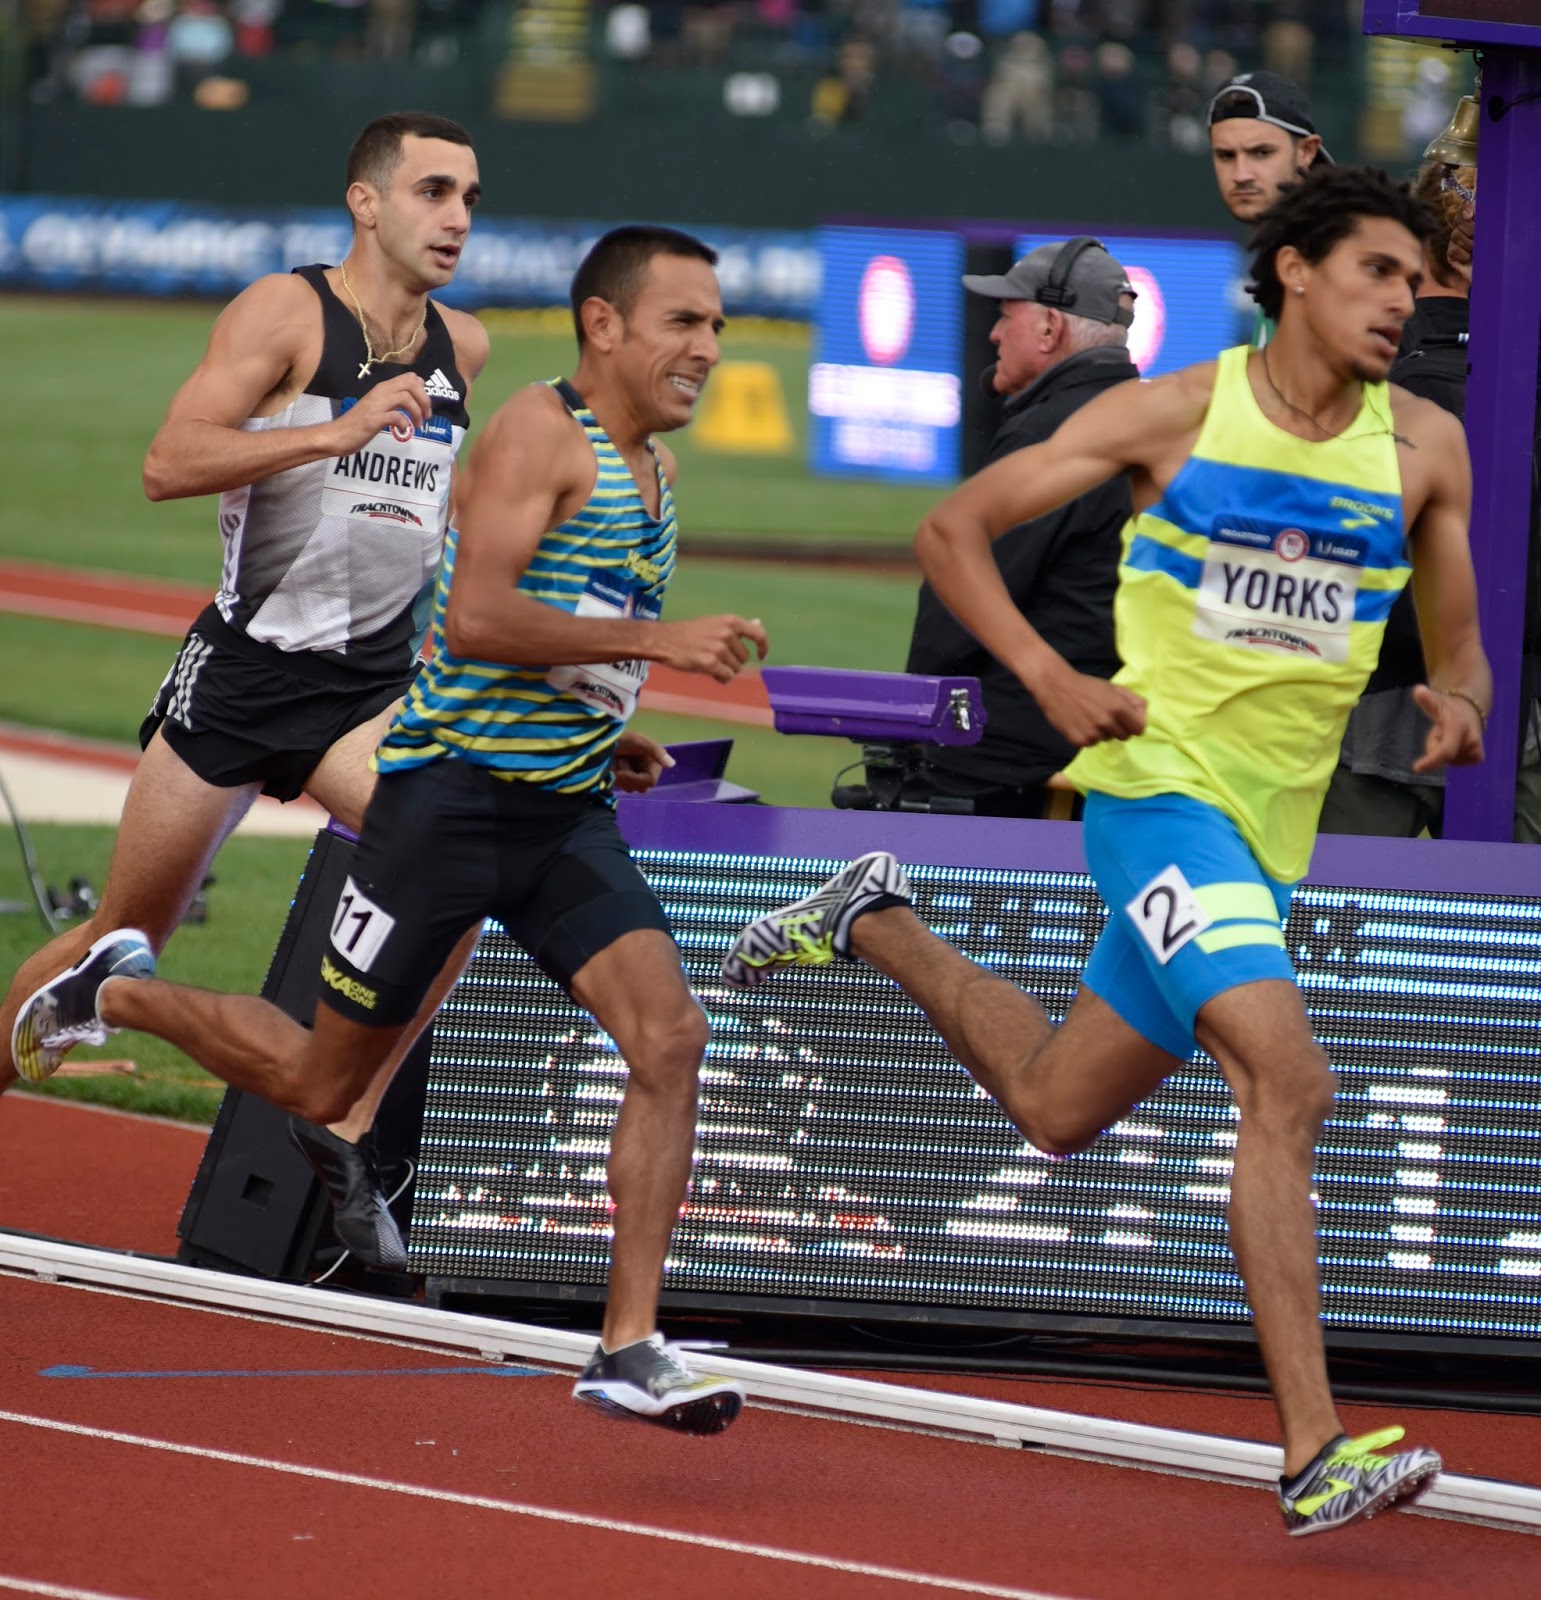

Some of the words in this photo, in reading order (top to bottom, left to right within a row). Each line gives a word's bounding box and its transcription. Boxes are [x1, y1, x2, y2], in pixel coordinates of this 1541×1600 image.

[423, 386, 460, 401] adidas
[333, 450, 440, 493] ANDREWS
[1329, 496, 1395, 520] BROOKS
[1223, 562, 1344, 624] YORKS
[333, 894, 374, 954] 11
[1143, 885, 1199, 952] 2
[349, 991, 376, 1010] ONE
[350, 982, 377, 1001] ONE
